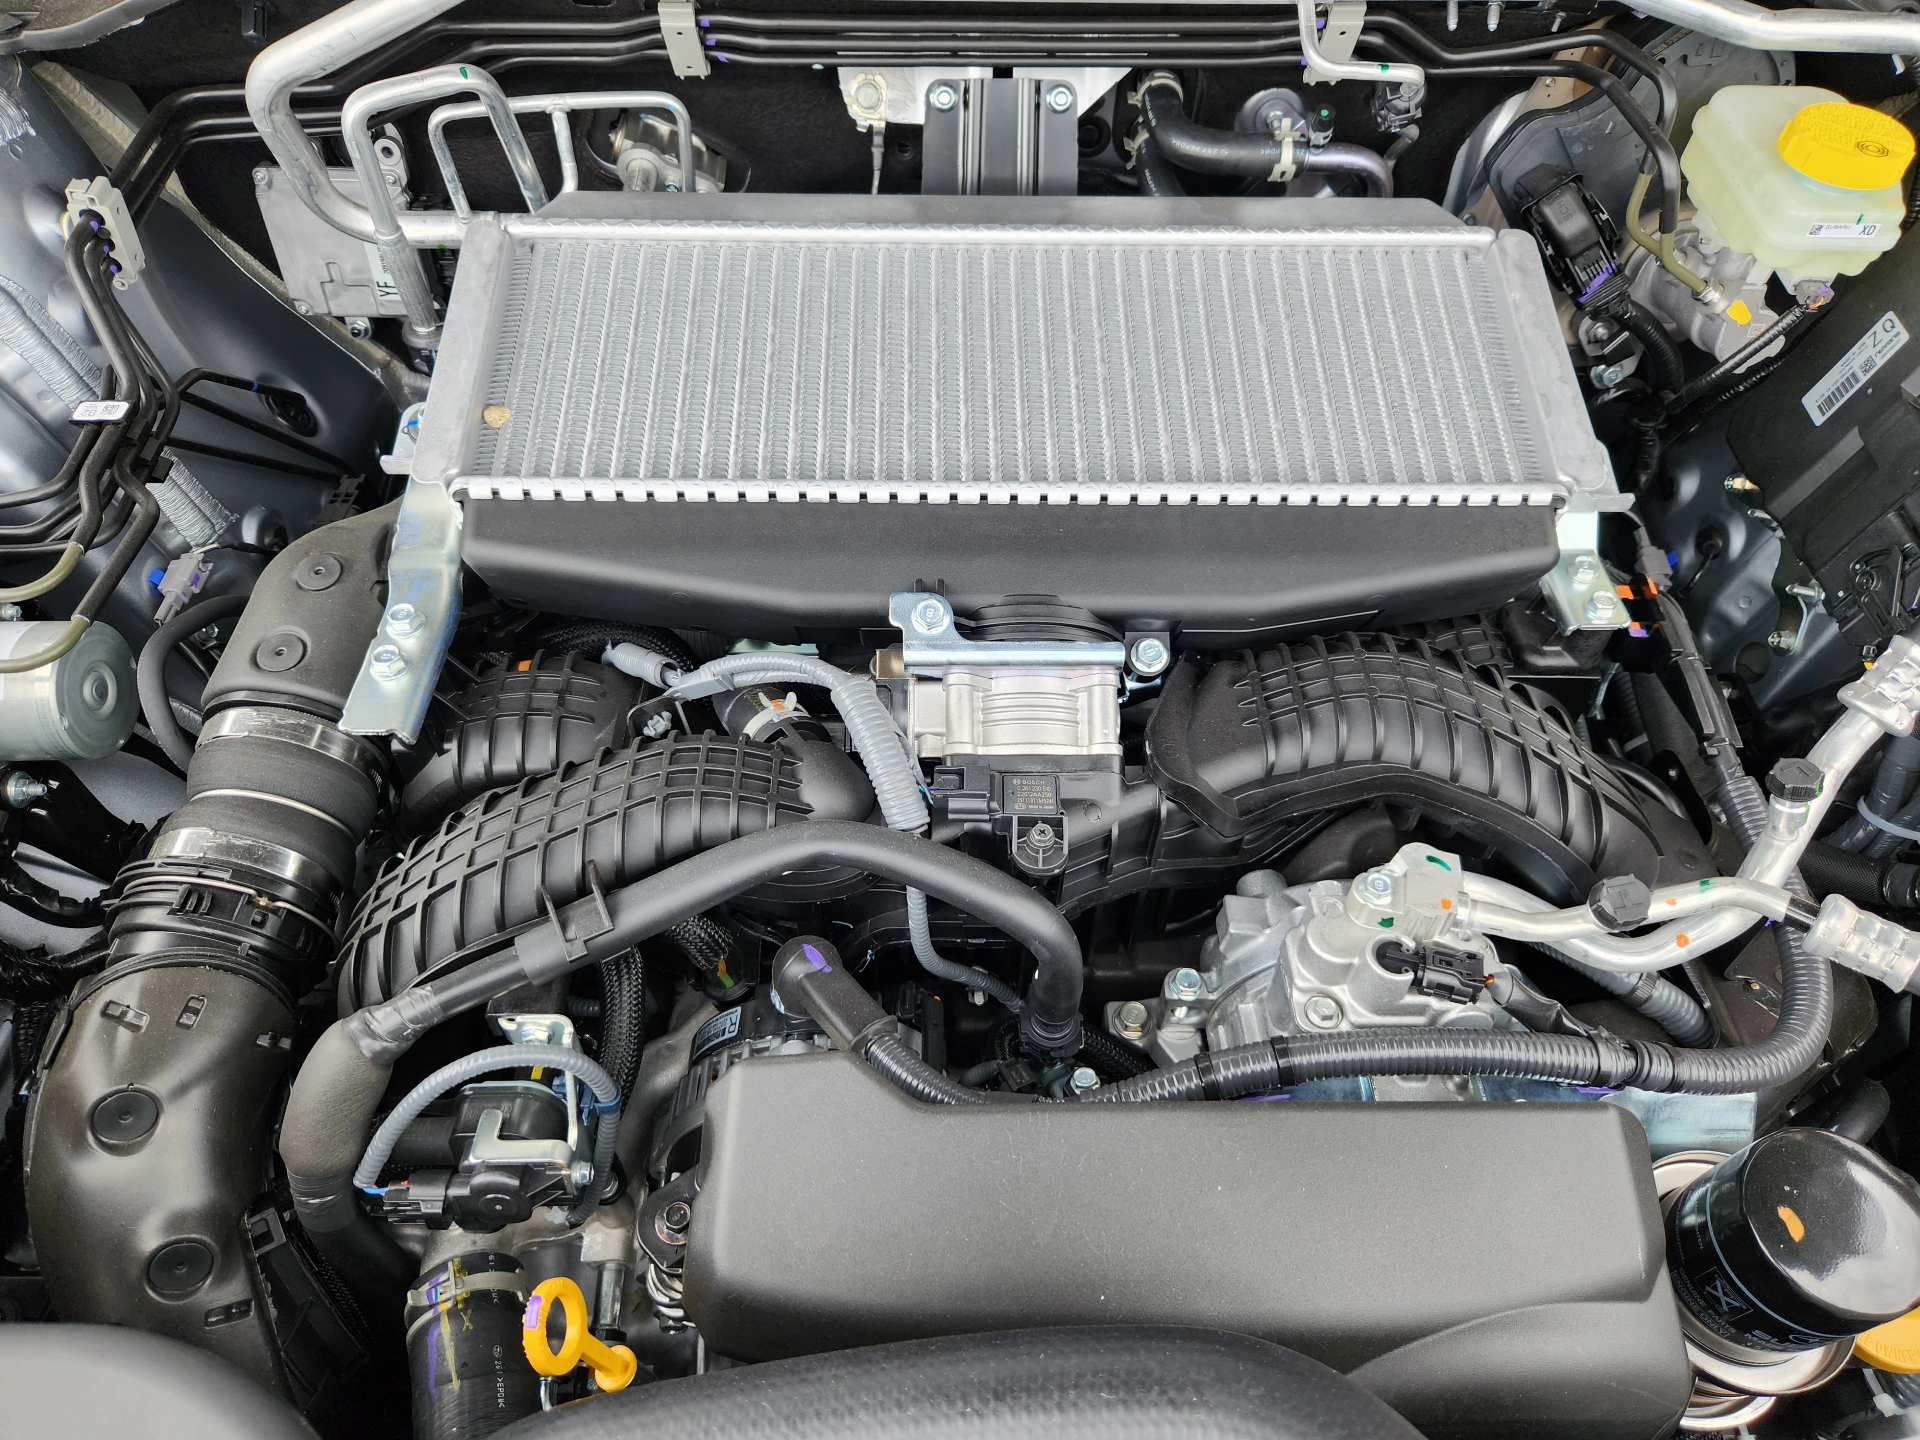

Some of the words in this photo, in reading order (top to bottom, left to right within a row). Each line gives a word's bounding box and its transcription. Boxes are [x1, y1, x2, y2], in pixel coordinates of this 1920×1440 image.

[1857, 224, 1877, 236] XD
[376, 281, 398, 297] YF
[1874, 330, 1901, 358] SUBARU
[1672, 1272, 1700, 1314] ENGINE
[1700, 1313, 1728, 1337] ONLY
[1679, 1267, 1707, 1309] GENUINE
[1707, 1309, 1736, 1334] PARTS
